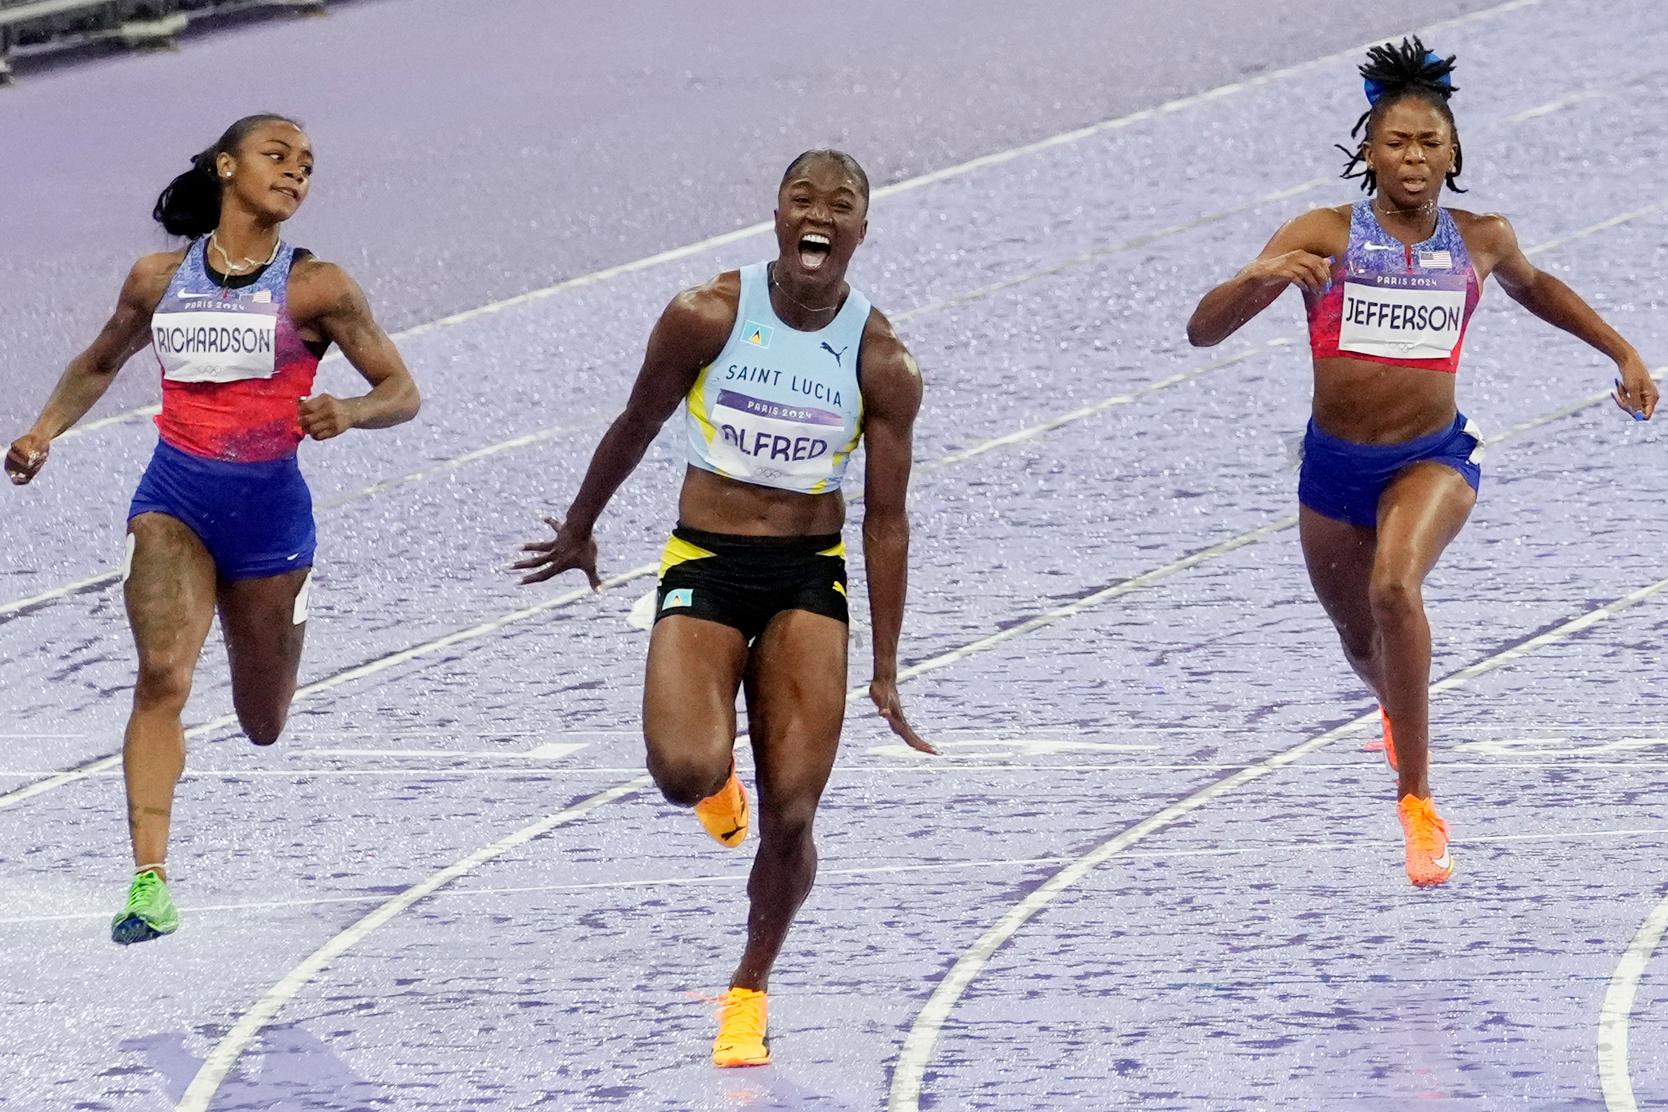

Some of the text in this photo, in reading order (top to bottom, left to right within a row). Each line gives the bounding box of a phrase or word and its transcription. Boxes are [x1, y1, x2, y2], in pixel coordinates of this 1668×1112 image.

[1377, 275, 1438, 287] PARIS 2024
[184, 300, 245, 311] PARIS 2024
[1346, 297, 1460, 331] JEFFERSON
[157, 327, 271, 353] RICHARDSON
[726, 365, 842, 408] SAINT LUCIA
[747, 401, 812, 420] PARIS 2024
[721, 424, 828, 461] ALFRED
